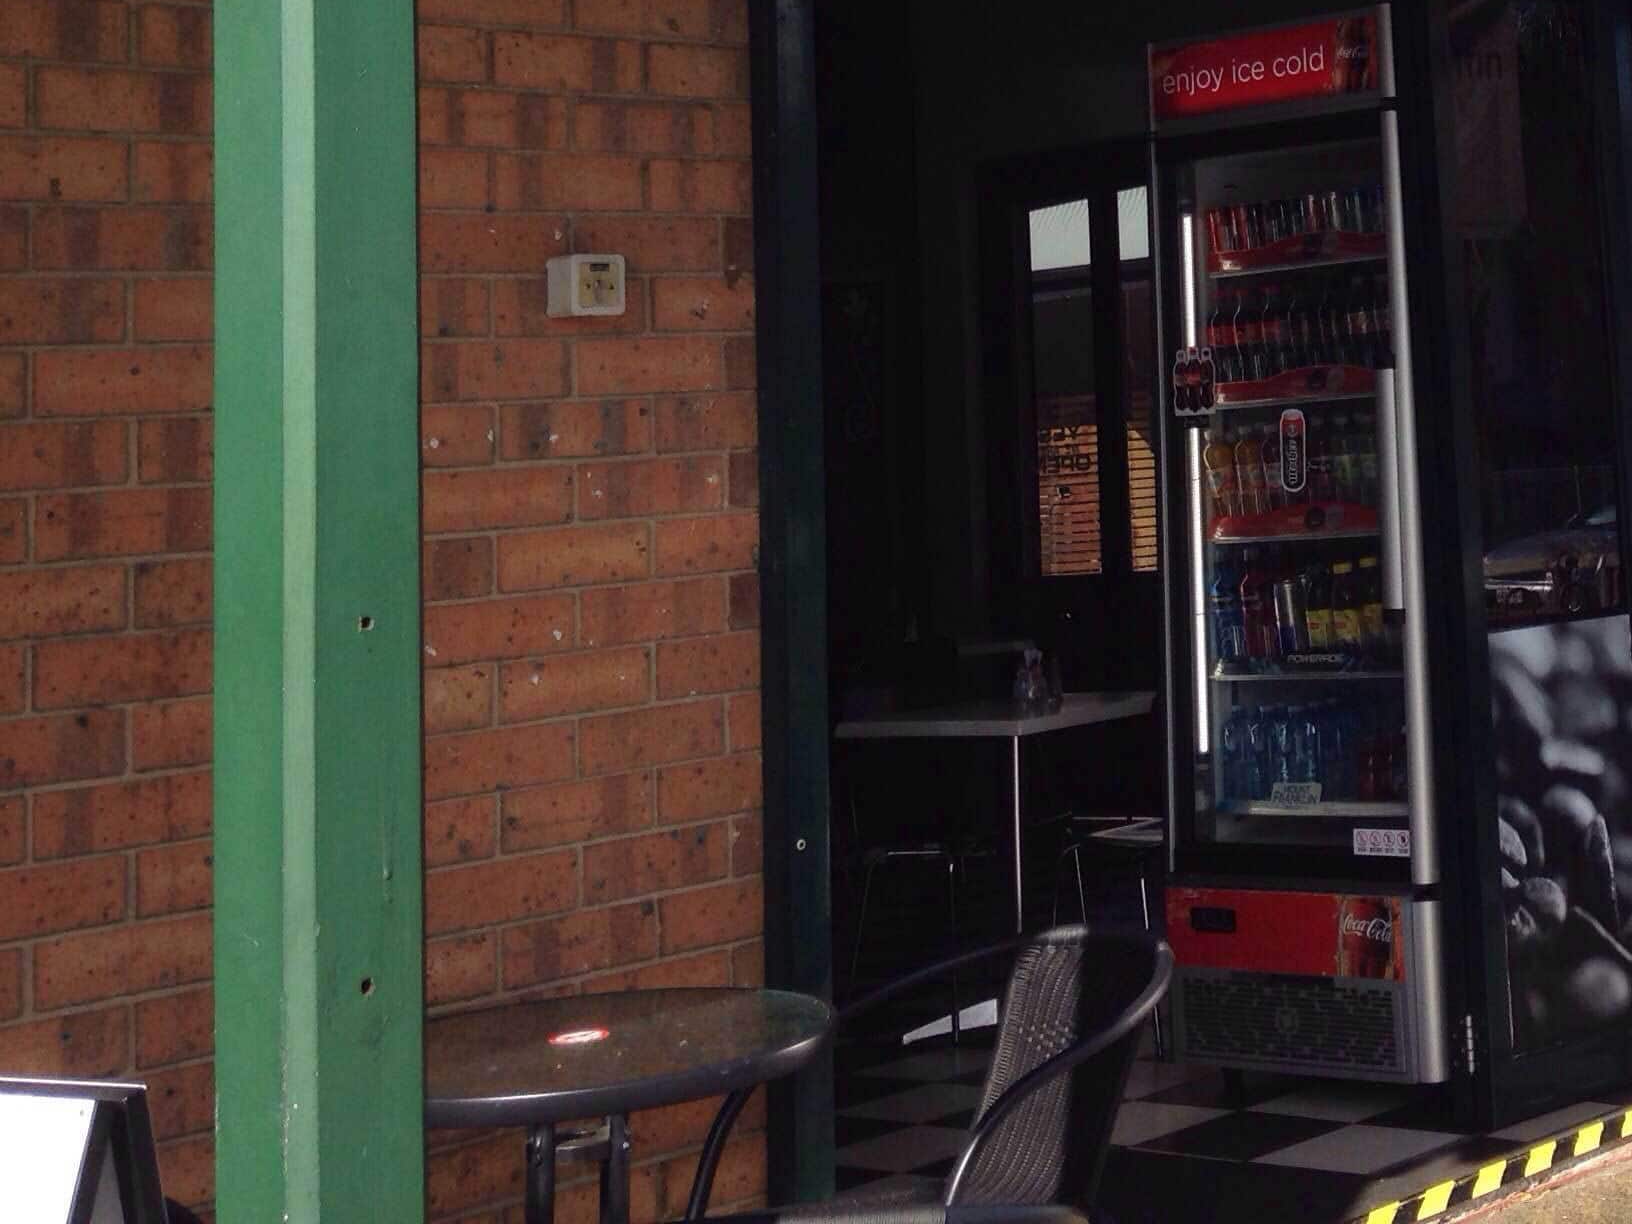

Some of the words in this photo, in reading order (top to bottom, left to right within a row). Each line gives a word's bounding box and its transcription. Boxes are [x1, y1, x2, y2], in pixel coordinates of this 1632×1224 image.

[1162, 65, 1224, 96] enjoy
[1231, 57, 1265, 84] ice
[1272, 44, 1325, 77] cold
